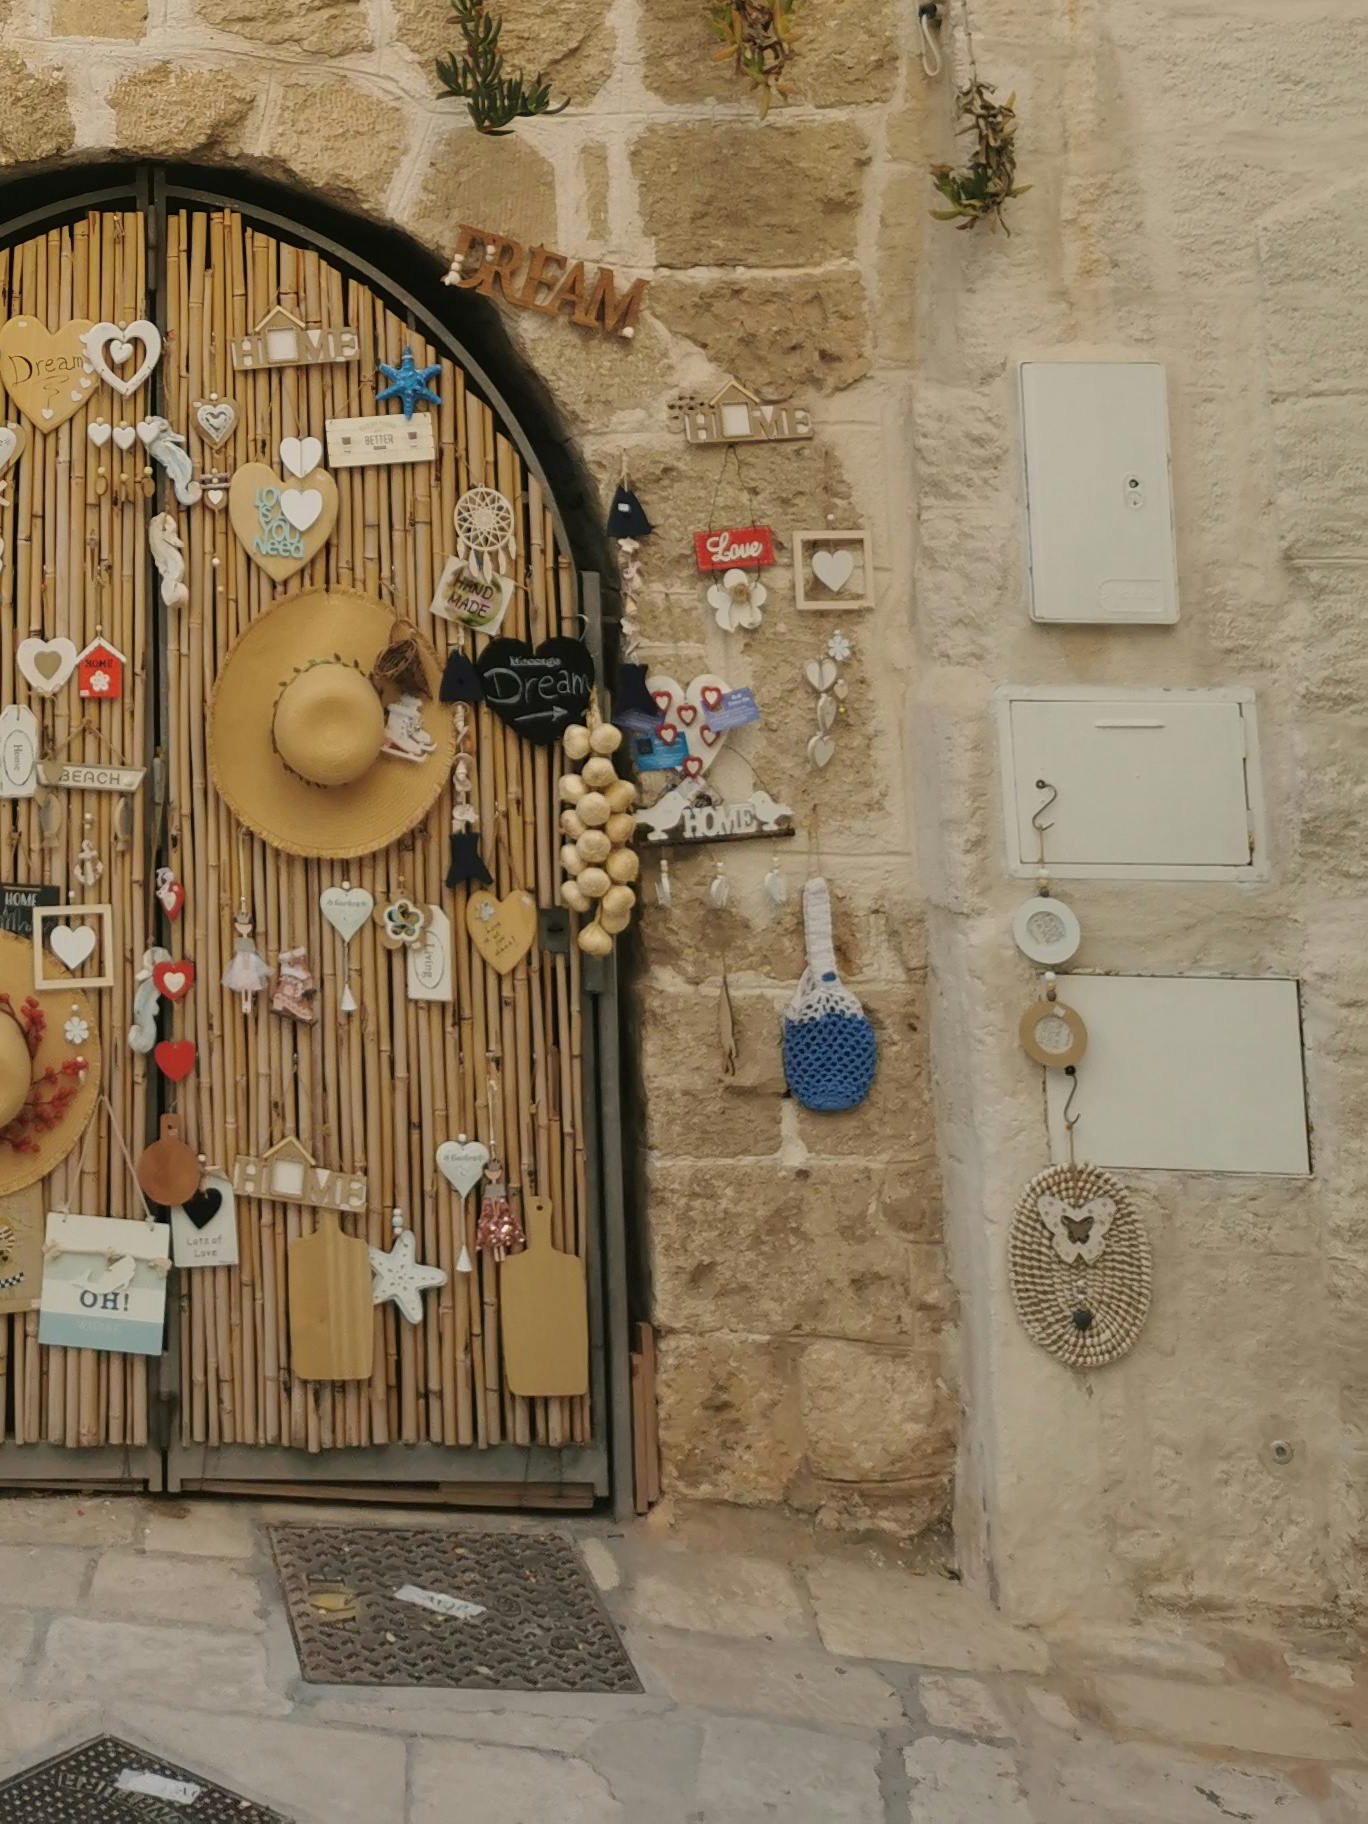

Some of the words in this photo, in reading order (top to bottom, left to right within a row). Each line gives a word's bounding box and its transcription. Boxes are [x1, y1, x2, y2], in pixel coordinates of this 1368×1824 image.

[458, 224, 650, 334] DREAM
[8, 355, 83, 386] Dream
[364, 434, 394, 446] BETTER
[706, 532, 763, 562] Love
[454, 572, 494, 600] HAND
[447, 592, 492, 619] MADE
[483, 667, 591, 704] Dream
[58, 770, 121, 785] BEACH
[682, 804, 758, 838] HOME
[4, 891, 37, 907] HOME
[186, 1237, 210, 1246] Lots
[194, 1249, 218, 1258] Love
[79, 1289, 130, 1312] OH!
